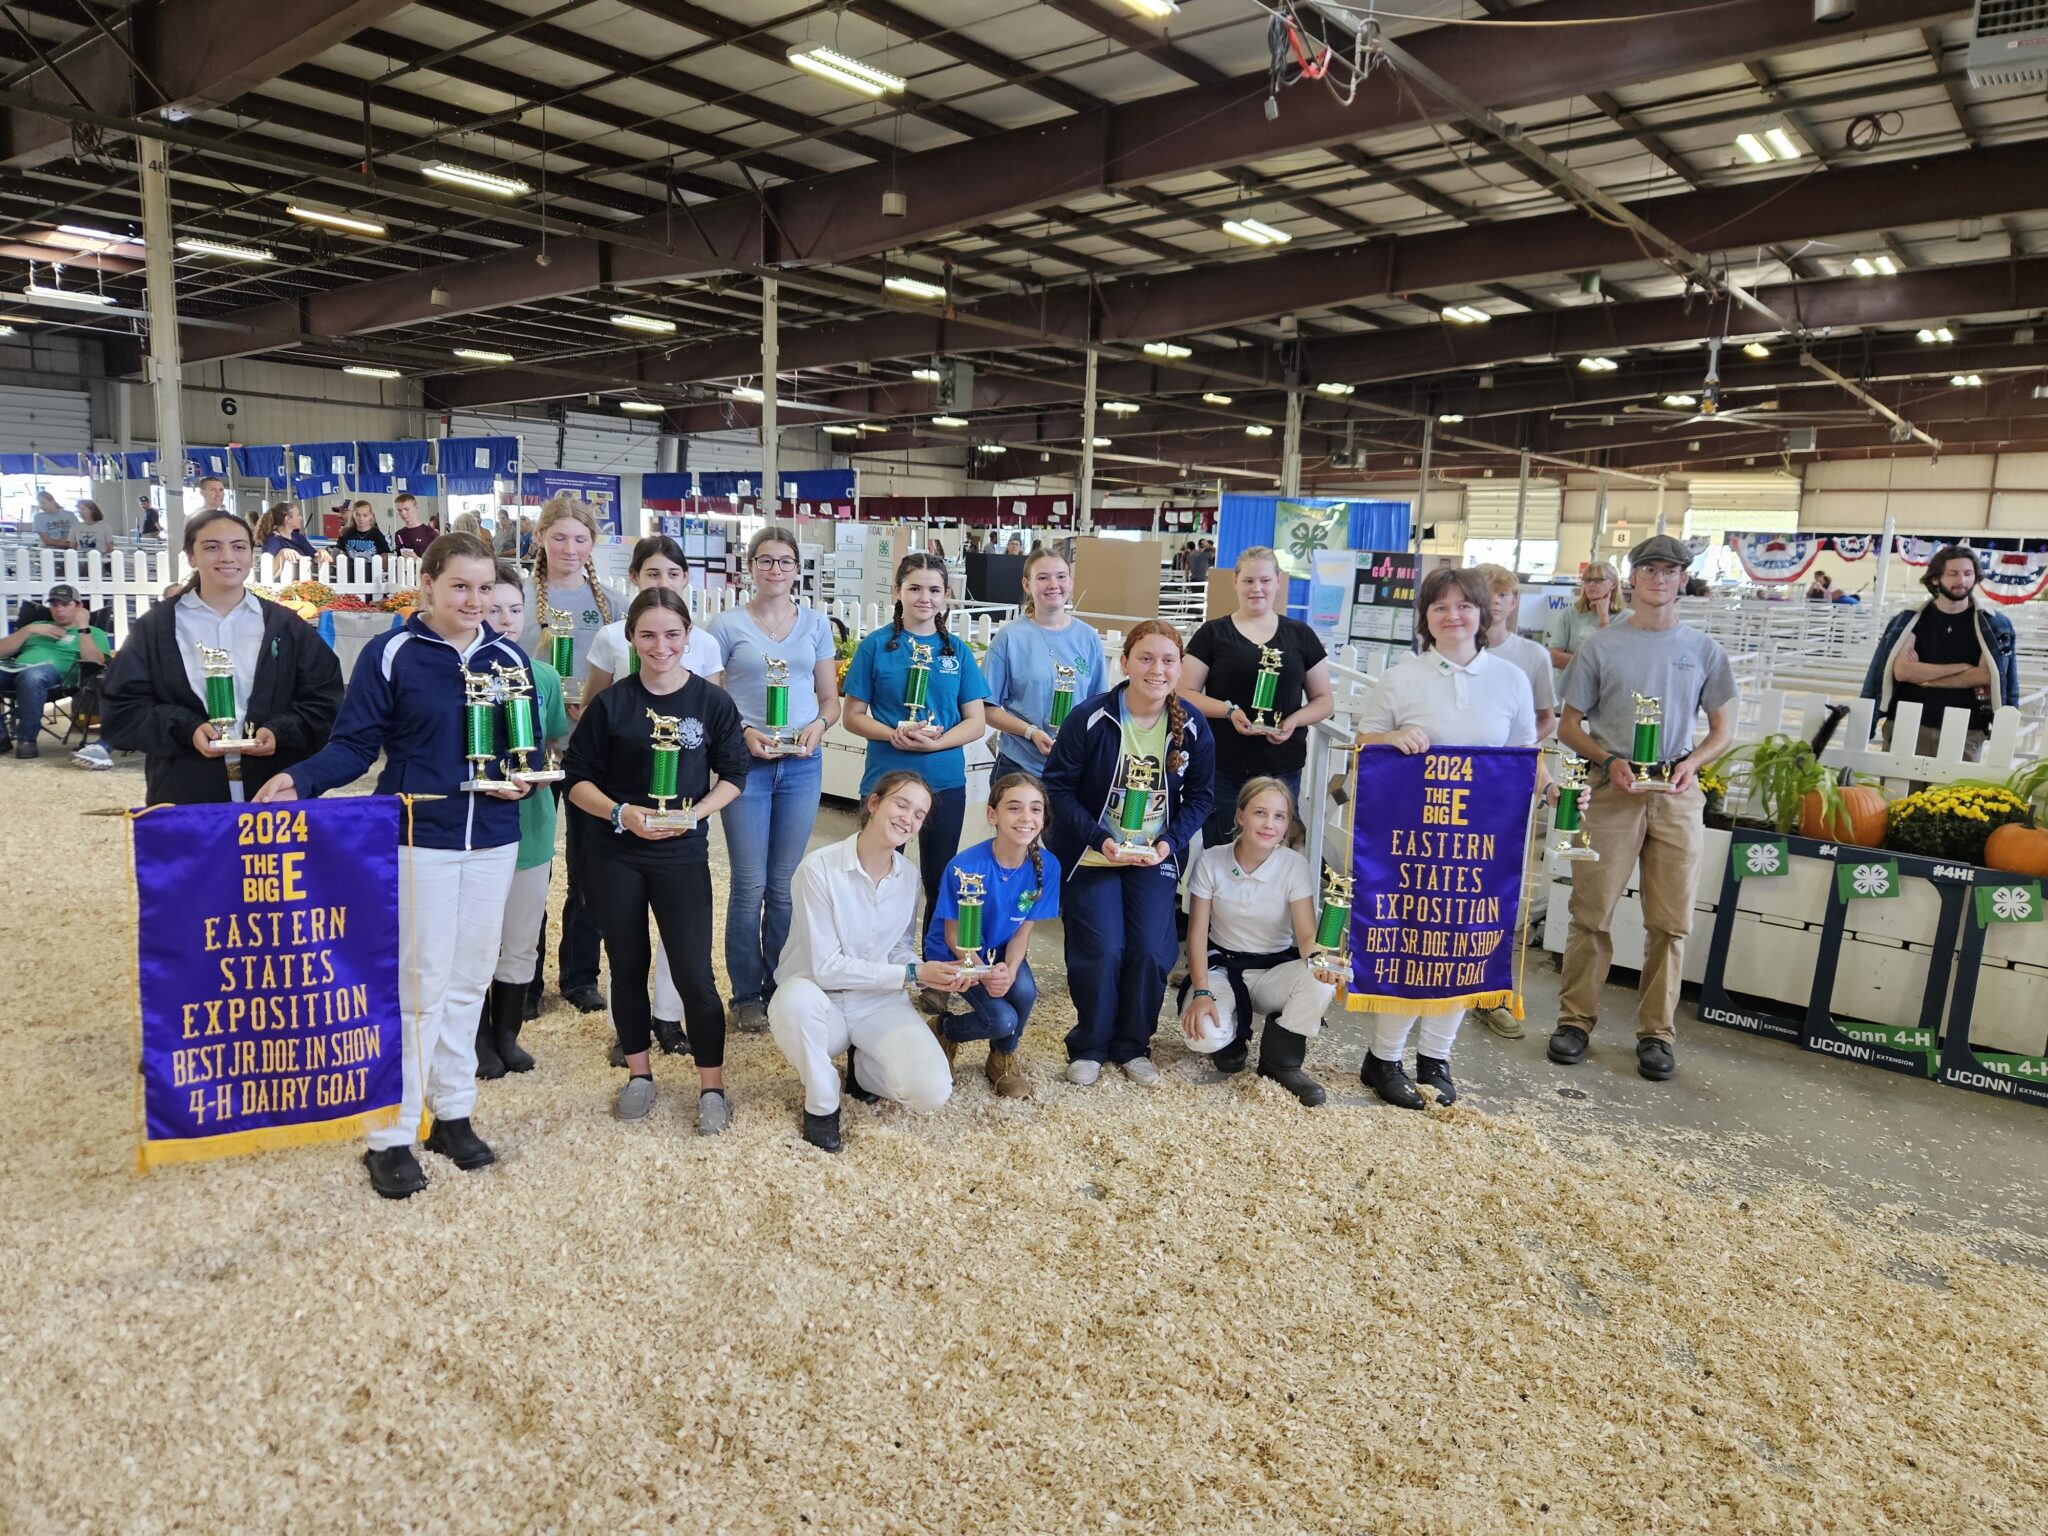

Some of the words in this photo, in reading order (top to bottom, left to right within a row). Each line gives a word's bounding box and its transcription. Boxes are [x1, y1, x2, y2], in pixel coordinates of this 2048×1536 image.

[221, 397, 237, 416] 6
[1424, 754, 1473, 782] 2024
[1423, 805, 1450, 825] BIG
[1424, 787, 1450, 804] THE
[1451, 788, 1470, 826] E
[238, 810, 308, 846] 2024
[1391, 829, 1496, 861] EASTERN
[241, 853, 279, 875] THE
[282, 852, 307, 901] E
[243, 877, 280, 903] BIG
[1399, 863, 1483, 893] STATES
[1375, 894, 1499, 925] EXPOSITION
[204, 907, 347, 951] EASTERN
[1366, 927, 1400, 954] BEST
[1400, 927, 1419, 955] SR.
[1421, 929, 1450, 957] DOE
[1452, 932, 1469, 957] IN
[1469, 929, 1505, 957] SHOW
[220, 949, 335, 992] STATES
[1374, 958, 1400, 984] 4-H
[1405, 959, 1455, 987] DAIRY
[1456, 958, 1488, 986] GOAT
[182, 984, 368, 1039] EXPOSITION
[1704, 1007, 1758, 1030] UCONN
[1763, 1024, 1799, 1036] EXTENSION
[1809, 1036, 1870, 1060] UCONN
[1876, 1053, 1914, 1067] EXTENSION
[1894, 1031, 1930, 1046] 4-H
[172, 1043, 226, 1088] BEST
[228, 1040, 260, 1077] JR.
[262, 1038, 300, 1072] DOE
[305, 1036, 327, 1071] IN
[331, 1025, 381, 1067] SHOW
[188, 1083, 232, 1125] 4-H
[241, 1077, 311, 1115] DAIRY
[316, 1067, 369, 1107] GOAT
[1946, 1068, 2011, 1093] UCONN
